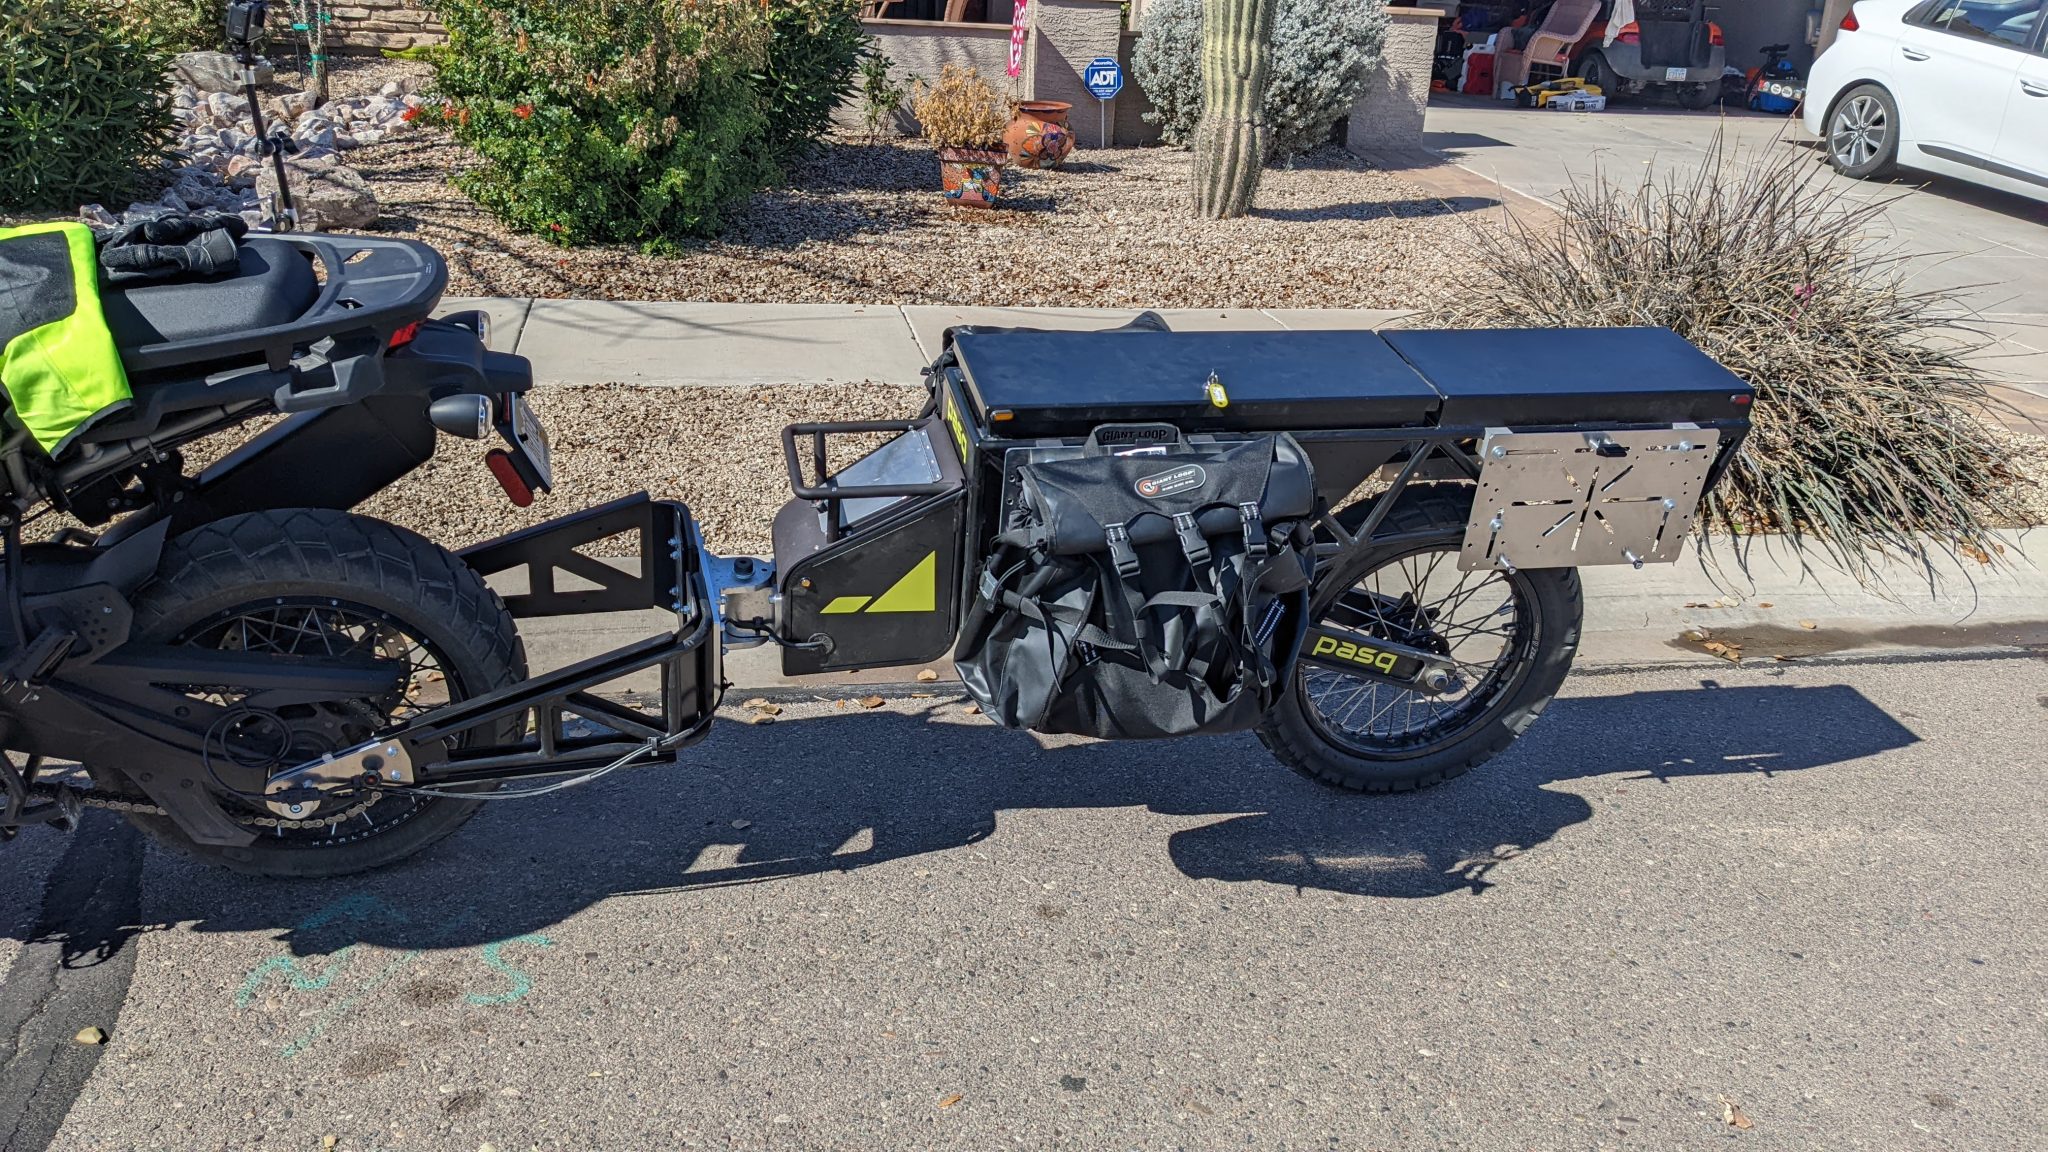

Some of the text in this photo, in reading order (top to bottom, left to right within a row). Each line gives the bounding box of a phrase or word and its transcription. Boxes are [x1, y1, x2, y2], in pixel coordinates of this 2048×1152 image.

[1090, 70, 1116, 86] ADT
[947, 397, 968, 464] pasq
[1102, 429, 1167, 441] GIANT LOOP
[1151, 475, 1173, 486] GIANT
[1173, 469, 1195, 480] LOOP
[1311, 636, 1398, 674] pasq
